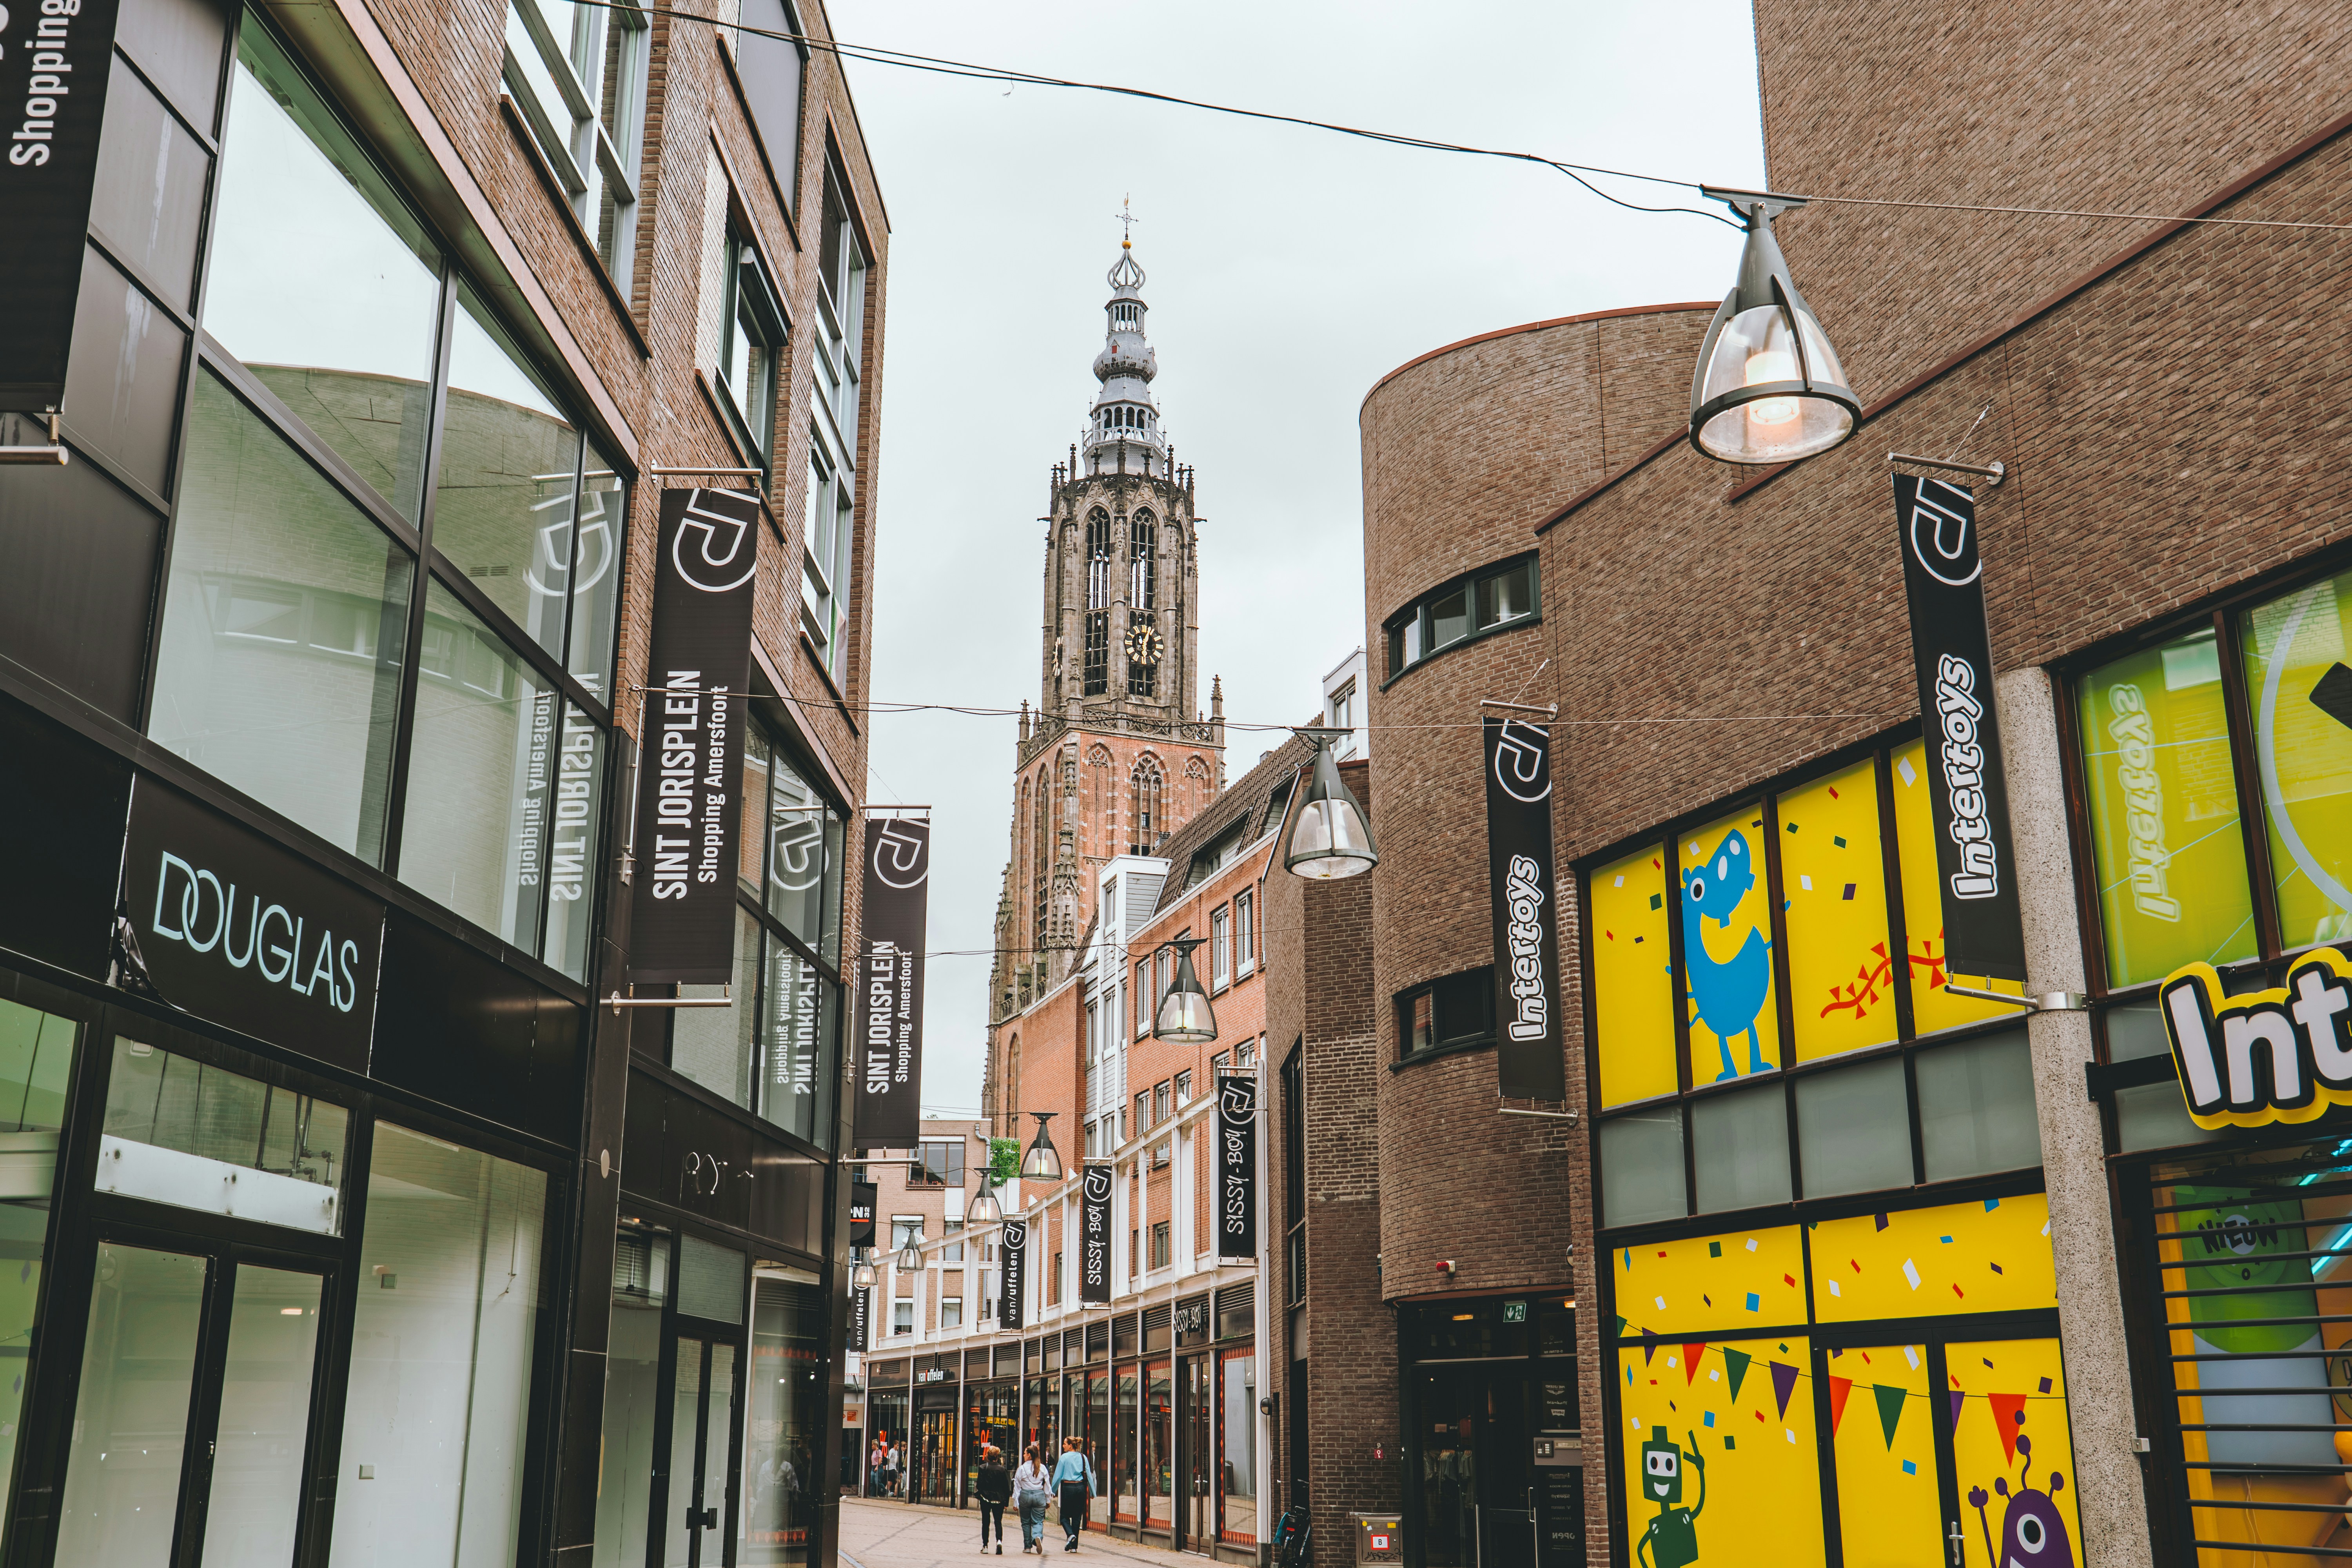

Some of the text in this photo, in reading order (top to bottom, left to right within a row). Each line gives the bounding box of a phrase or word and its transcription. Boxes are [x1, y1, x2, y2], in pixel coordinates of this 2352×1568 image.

[9, 0, 80, 166] Shopping
[653, 671, 701, 899] SINT JORISPLEIN
[698, 686, 728, 883] Shopping Amersfoort
[1936, 653, 1998, 899] Intertoys
[153, 850, 358, 1013] DOUGLAS
[1506, 854, 1547, 1042] Intertoys
[866, 941, 894, 1094] SINT JORISPLEIN
[895, 951, 913, 1083] Shopping Amersfoort
[864, 1207, 870, 1218] 32
[1008, 1252, 1018, 1321] van/uffelen
[2198, 1217, 2278, 1254] NIEUW
[856, 1292, 864, 1346] van/uffelen
[918, 1368, 943, 1383] van/uffelen
